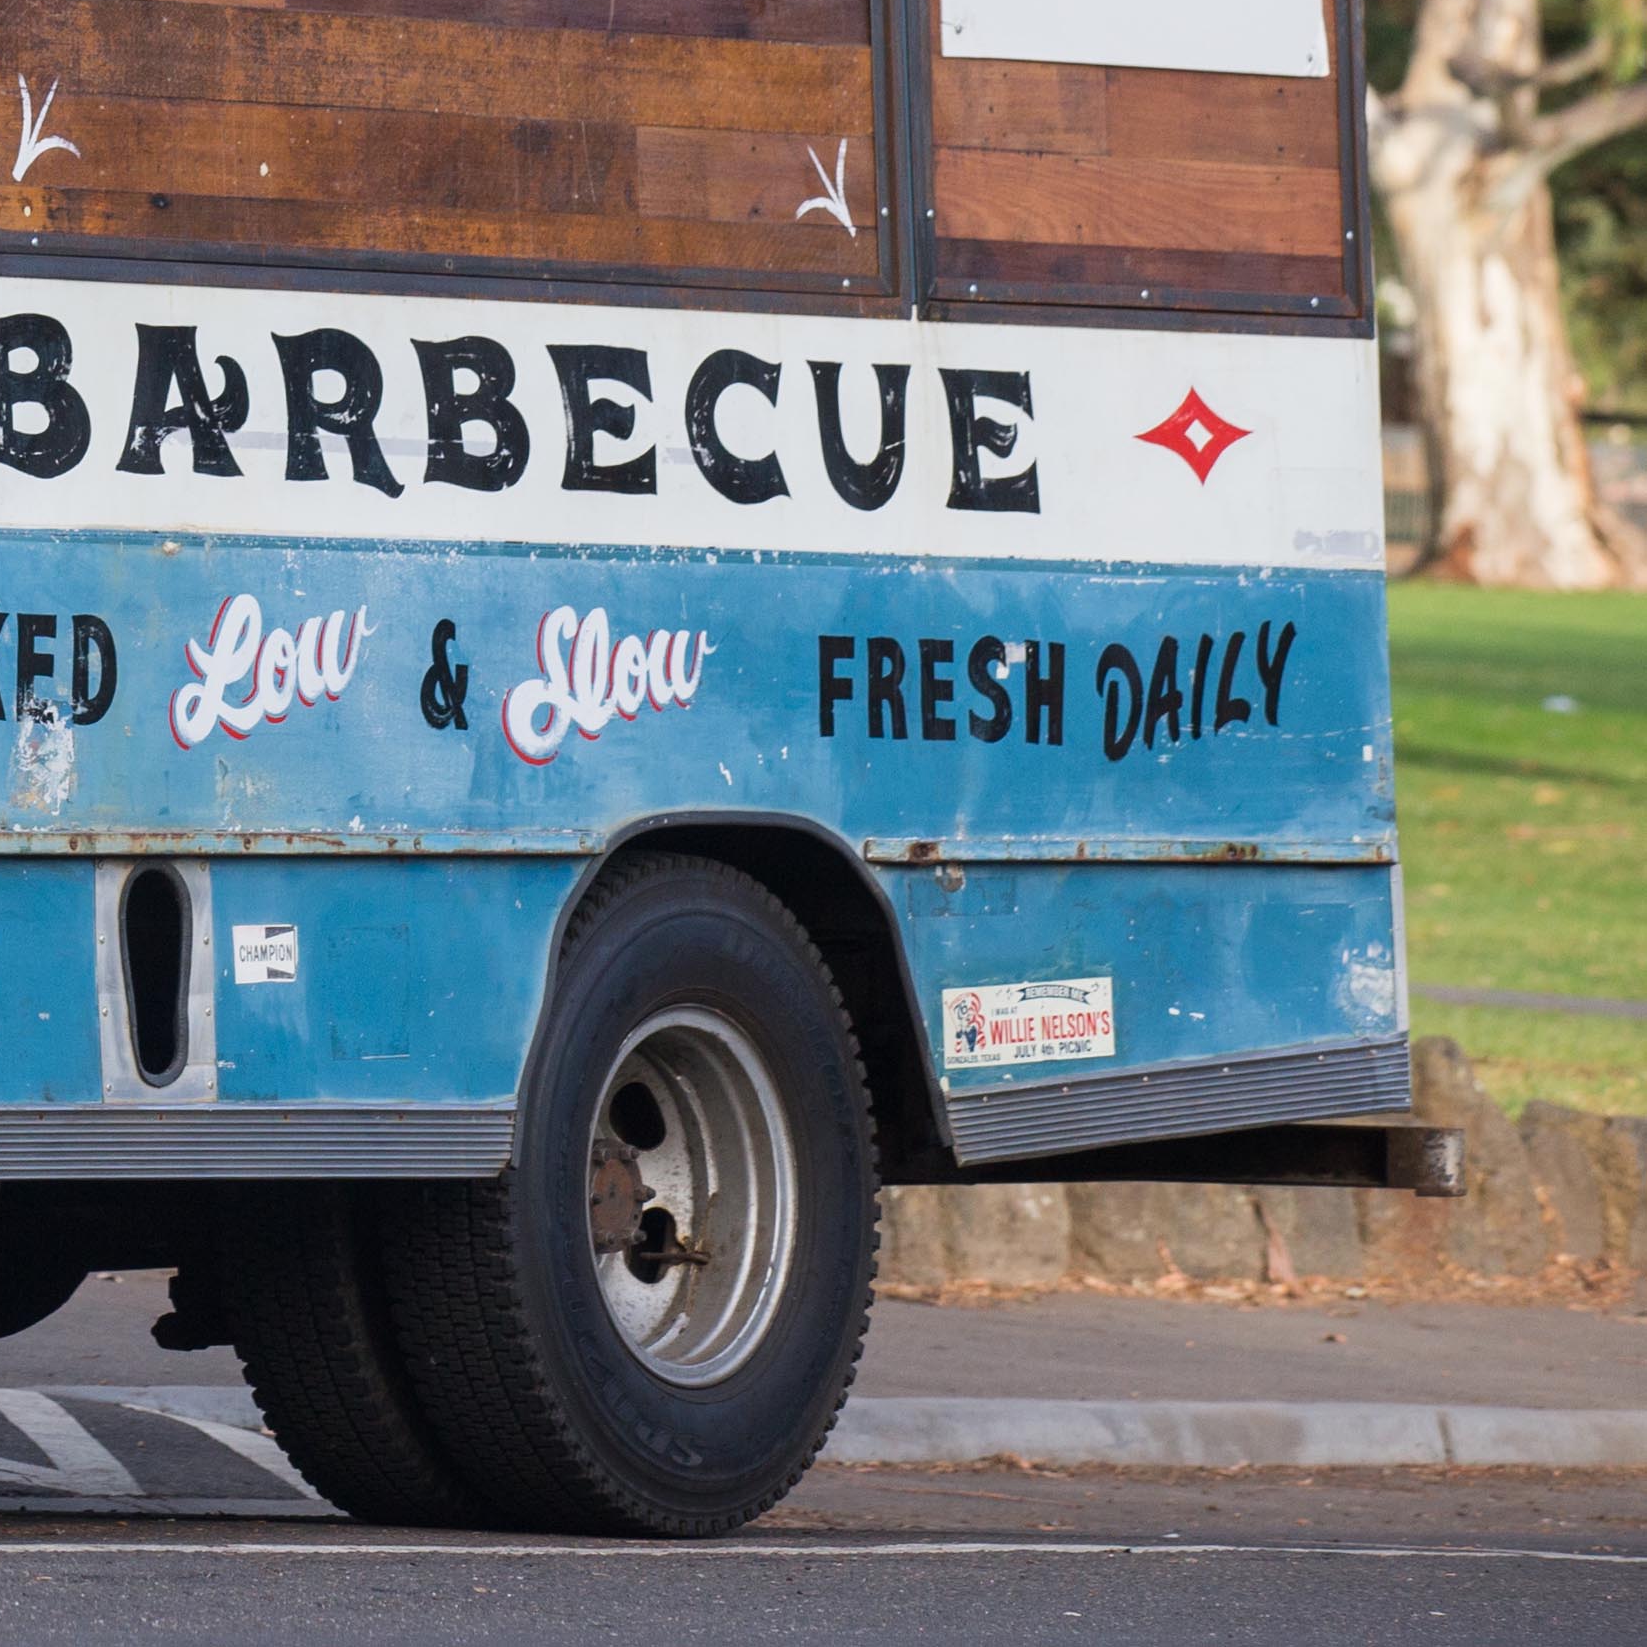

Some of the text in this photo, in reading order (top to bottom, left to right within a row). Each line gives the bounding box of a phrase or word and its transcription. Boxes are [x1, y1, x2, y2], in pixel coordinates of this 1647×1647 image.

[168, 592, 378, 751] Low
[420, 617, 469, 732] &
[501, 603, 717, 767] Slow
[817, 633, 1064, 747] FRESH
[1096, 619, 1298, 762] DAILY
[239, 944, 293, 962] CHAMPION
[989, 1010, 1111, 1046] WILLIE NELSON'S
[1014, 1043, 1037, 1059] JULY
[1059, 1039, 1093, 1055] PICNIC
